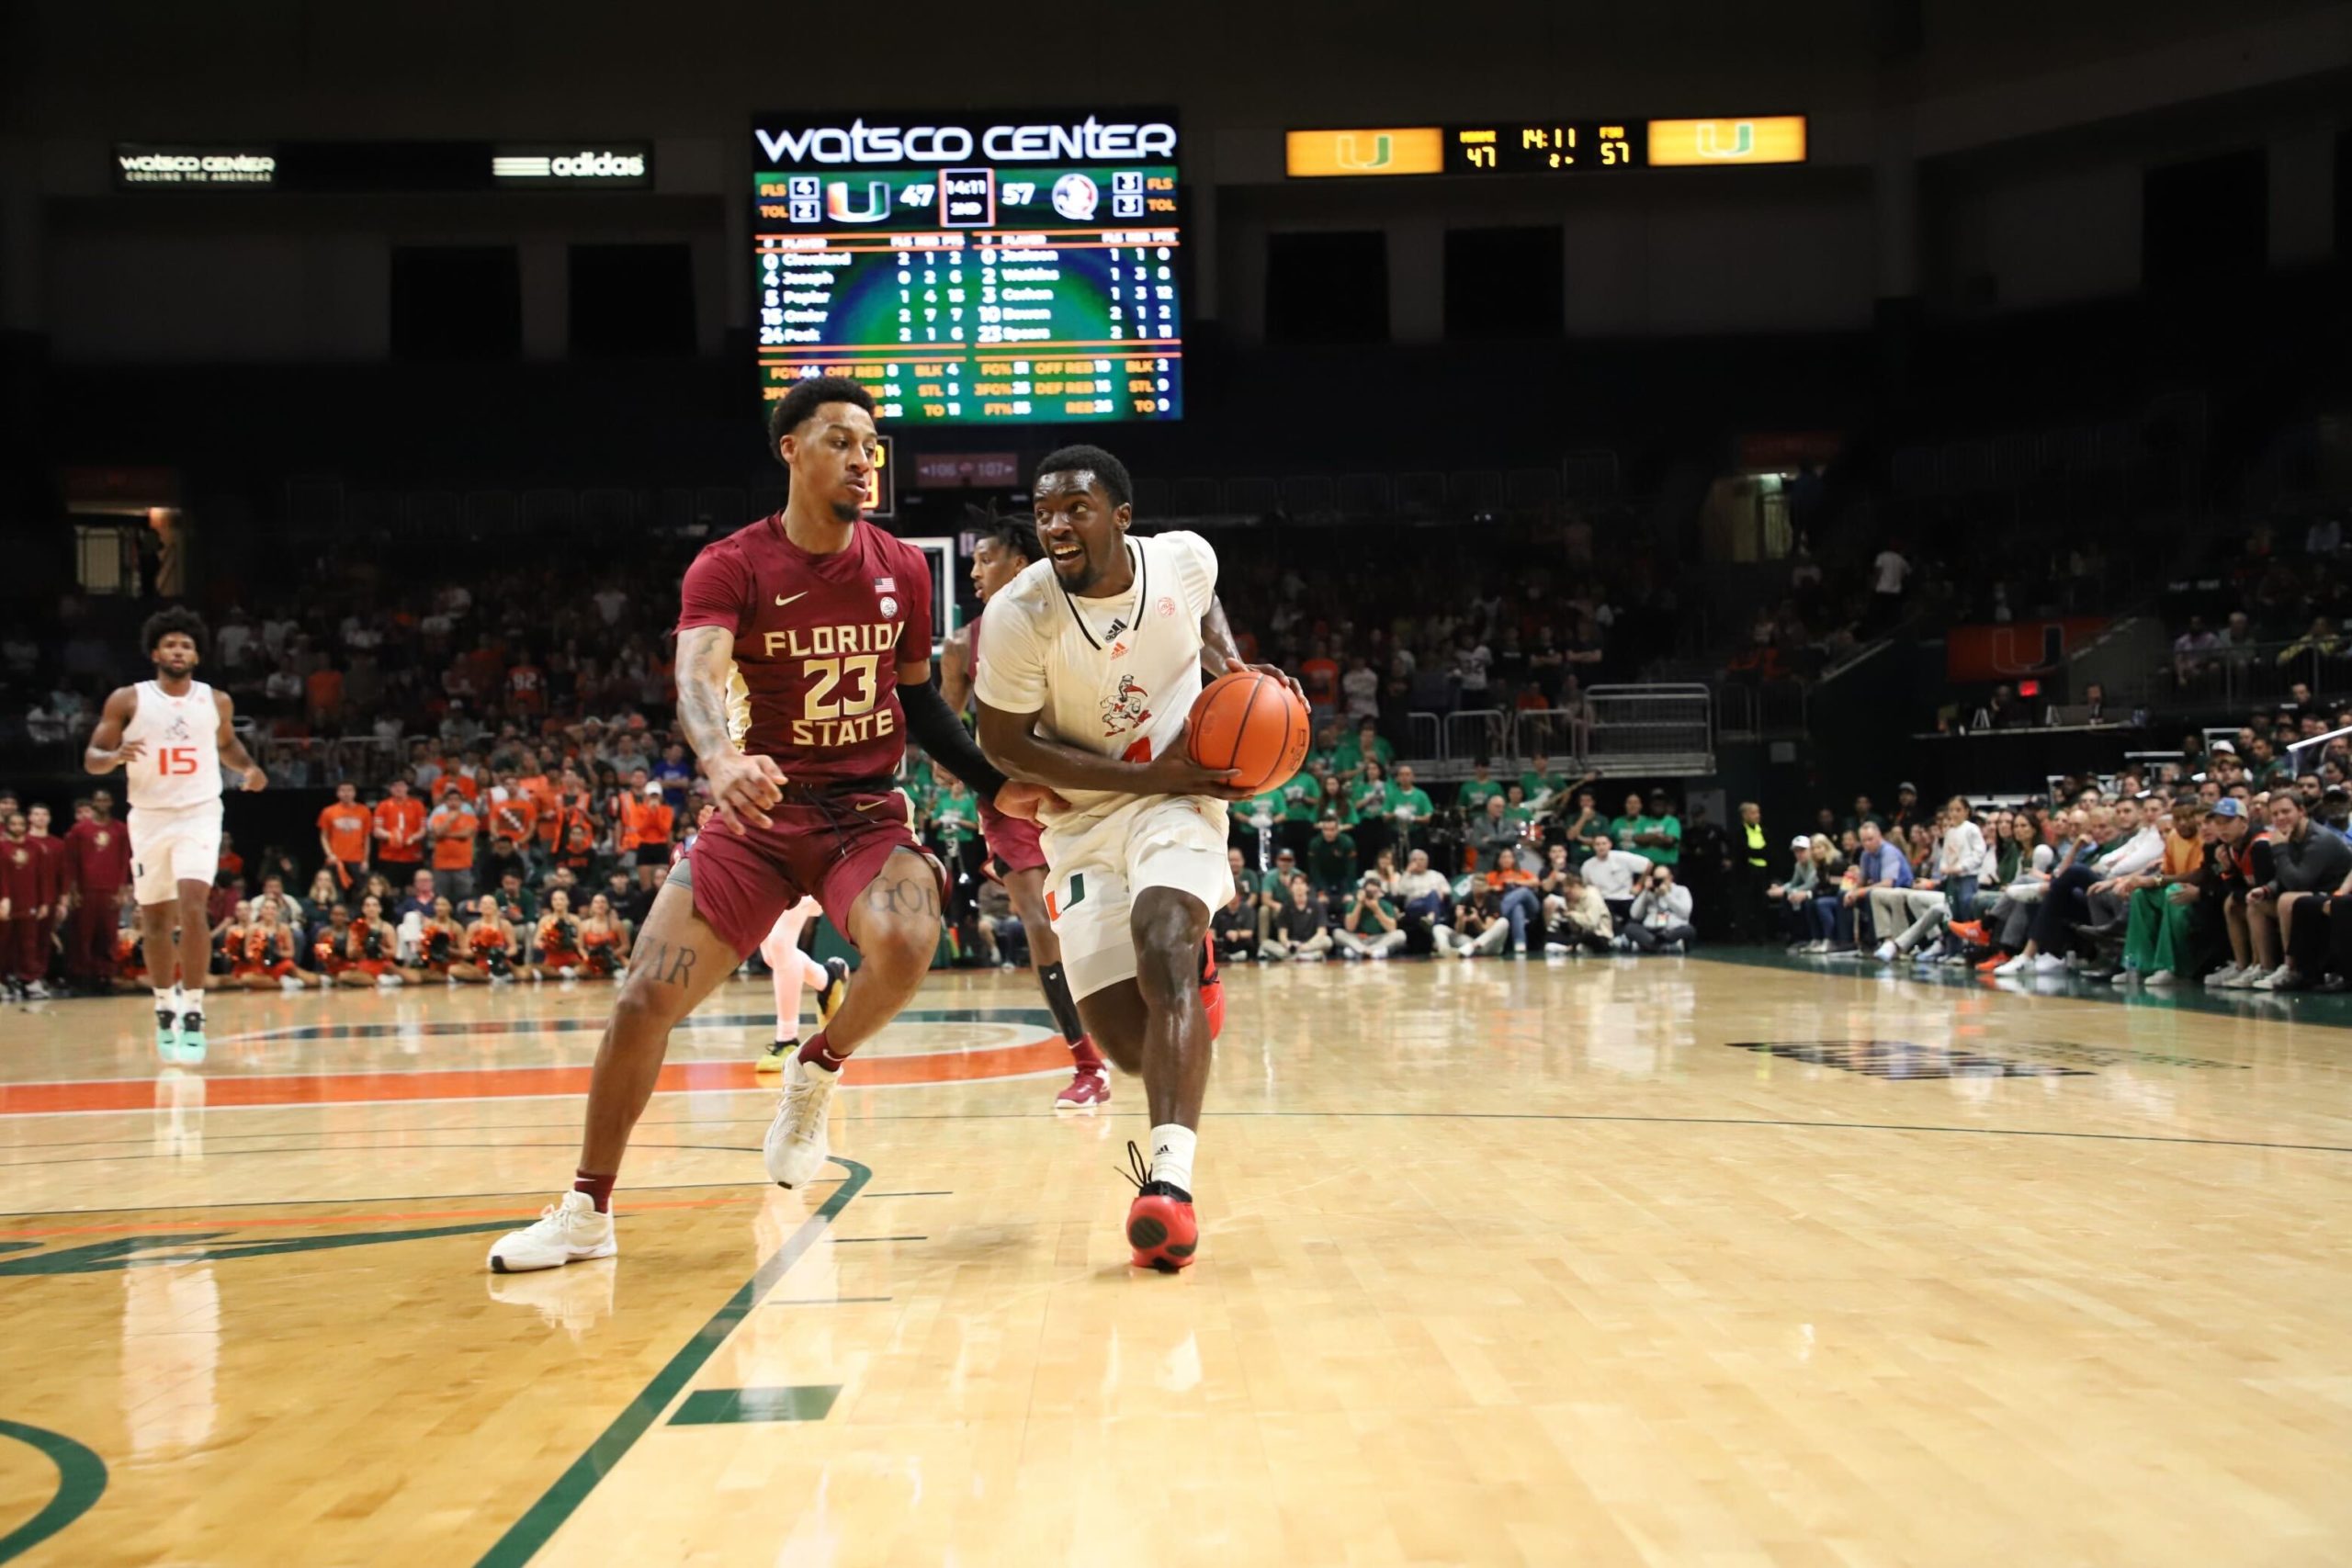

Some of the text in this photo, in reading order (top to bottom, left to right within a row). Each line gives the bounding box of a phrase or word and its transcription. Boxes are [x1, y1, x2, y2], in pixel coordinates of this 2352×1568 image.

[1522, 128, 1576, 149] 14:11
[1697, 122, 1753, 158] U
[1337, 133, 1393, 168] U
[1466, 146, 1496, 167] 47
[1600, 142, 1629, 164] 57
[551, 152, 644, 175] adidas
[126, 172, 271, 182] COOLING THE AMERICAS
[1147, 177, 1173, 190] FLS
[760, 184, 786, 197] FLS
[899, 184, 934, 207] 47
[946, 180, 986, 195] 14:11
[1001, 183, 1035, 205] 57
[828, 182, 890, 222] U
[1147, 198, 1176, 211] TOL
[760, 206, 788, 218] TOL
[763, 253, 779, 270] 0
[898, 252, 910, 265] 2
[924, 251, 934, 265] 1
[949, 251, 962, 265] 2
[980, 248, 997, 265] 0
[1110, 247, 1119, 262] 1
[1136, 247, 1145, 261] 1
[763, 270, 779, 288] 4
[981, 267, 997, 285] 2
[1110, 267, 1120, 281] 1
[899, 289, 910, 303] 1
[924, 289, 938, 303] 4
[982, 286, 997, 303] 3
[1110, 287, 1120, 300] 1
[924, 308, 937, 321] 7
[950, 308, 963, 321] 7
[978, 306, 1001, 323] 10
[1110, 306, 1122, 320] 2
[1136, 306, 1147, 320] 1
[1159, 305, 1170, 319] 2
[760, 327, 784, 344] 24
[926, 327, 936, 341] 1
[1136, 324, 1147, 339] 1
[824, 366, 853, 378] OFF
[914, 365, 944, 377] BLK
[946, 363, 959, 376] 4
[1035, 362, 1063, 374] OFF
[1125, 360, 1154, 373] BLK
[918, 384, 944, 397] STL
[1035, 381, 1064, 394] DEF
[1128, 380, 1155, 393] STL
[923, 404, 944, 416] TO
[1134, 400, 1155, 412] TO
[1992, 625, 2065, 675] U
[804, 654, 879, 720] 23
[792, 708, 893, 746] STATE
[159, 747, 198, 775] 15
[1045, 873, 1085, 922] U
